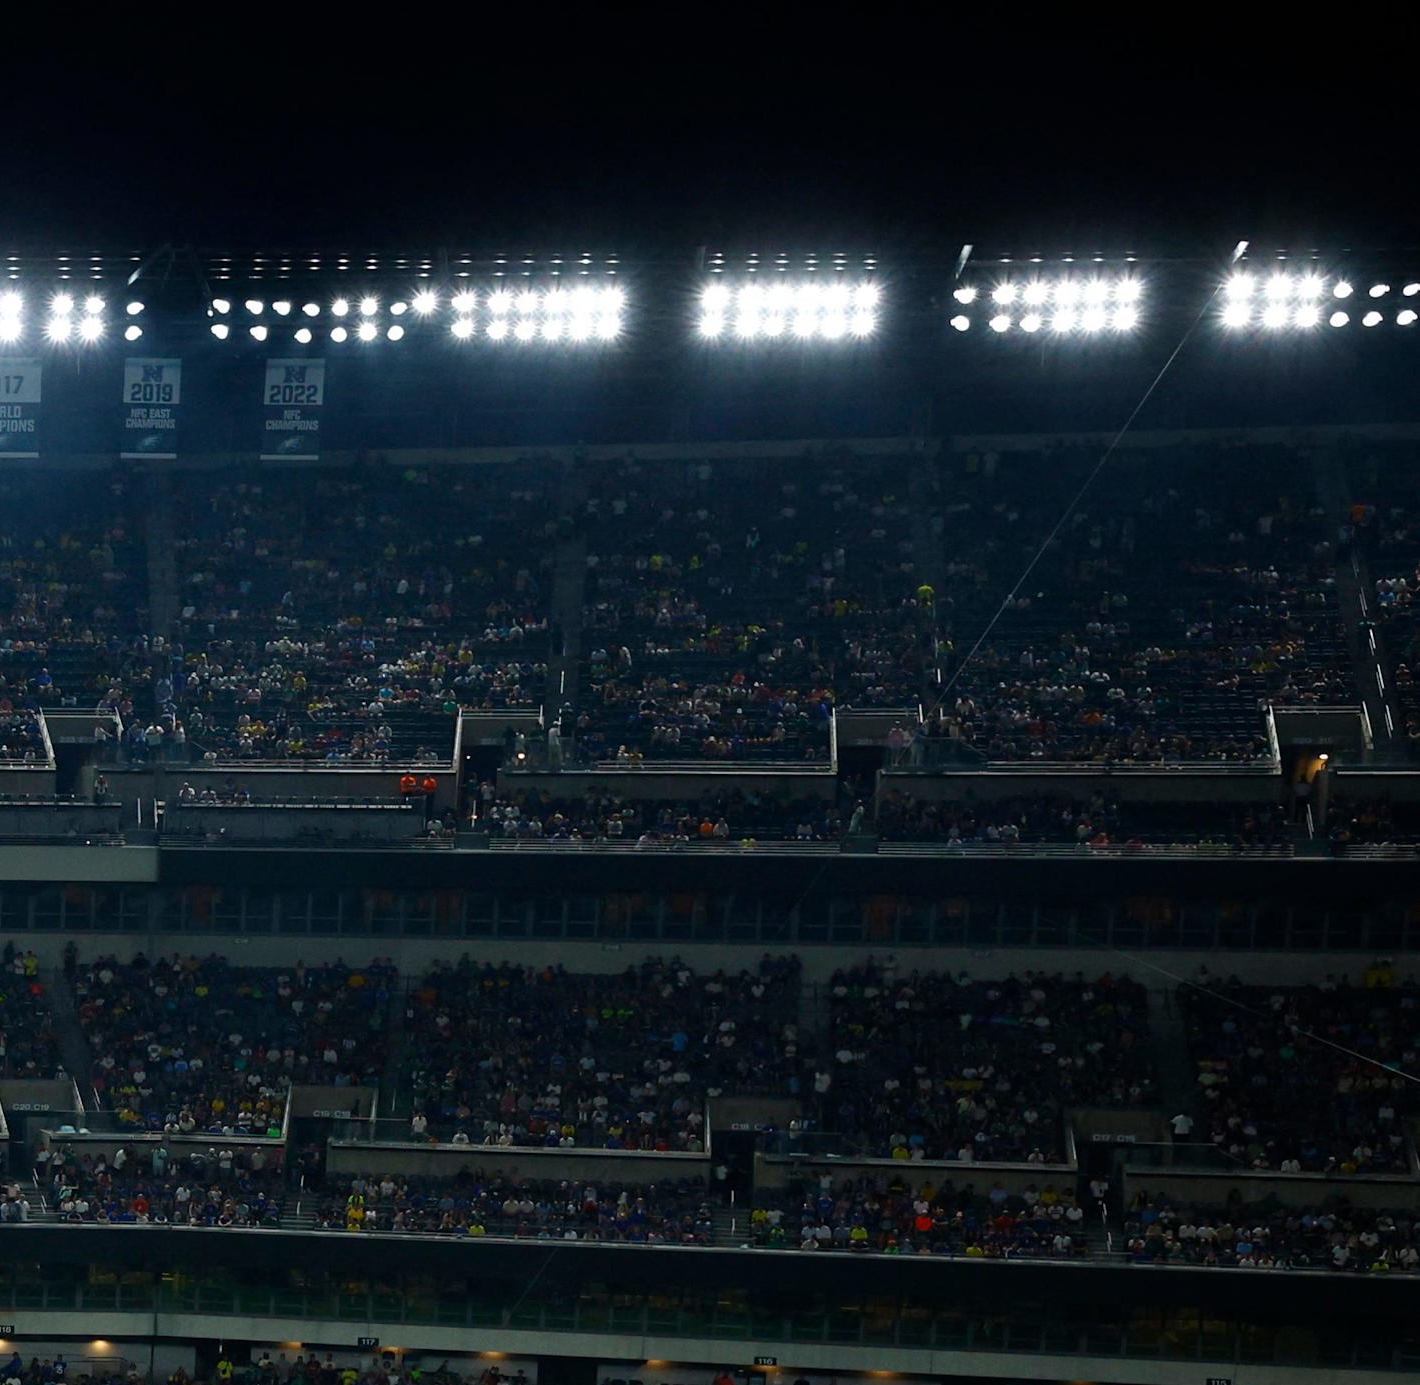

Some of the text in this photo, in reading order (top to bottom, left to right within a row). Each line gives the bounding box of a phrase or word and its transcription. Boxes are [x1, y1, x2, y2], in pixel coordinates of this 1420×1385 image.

[131, 383, 173, 402] 2019
[270, 385, 318, 403] 2022
[131, 408, 171, 418] NFC EAST
[283, 410, 301, 420] NFC
[126, 418, 175, 429] CHAMPIONS
[265, 420, 319, 431] CHAMPIONS
[361, 1337, 375, 1346] 117
